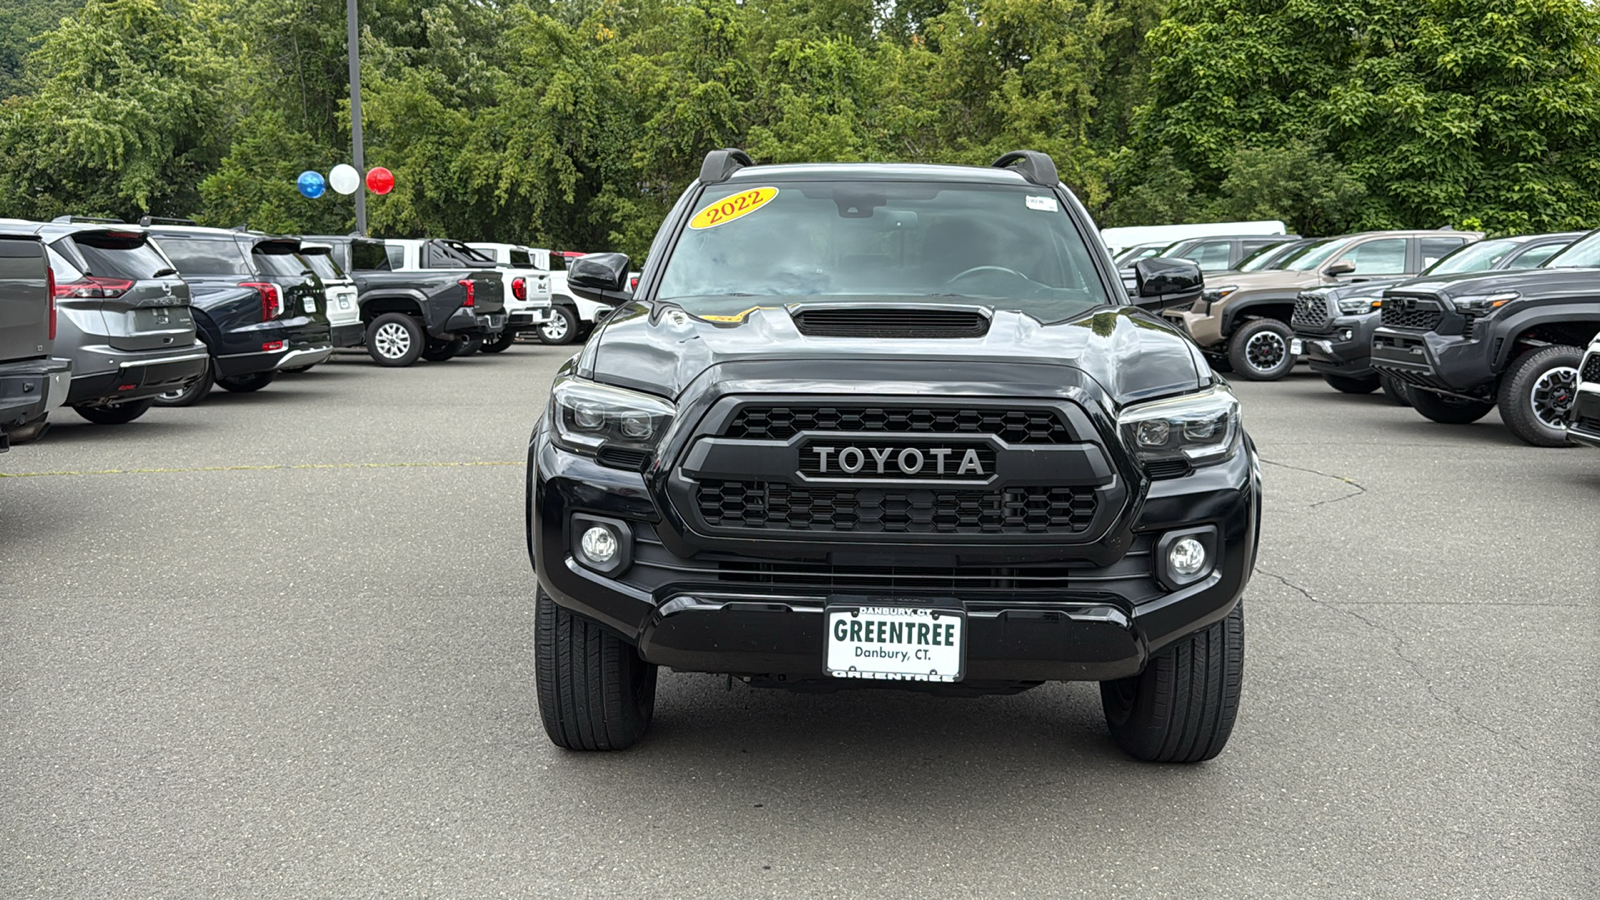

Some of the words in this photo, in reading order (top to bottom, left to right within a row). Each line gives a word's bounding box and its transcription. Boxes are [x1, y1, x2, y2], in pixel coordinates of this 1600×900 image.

[706, 191, 764, 224] 2022
[812, 446, 985, 475] TOYOTA
[859, 606, 915, 618] DANBURY,
[833, 619, 955, 647] GREENTREE
[854, 646, 911, 662] Danbury,
[915, 649, 931, 661] CT.
[831, 670, 955, 683] GREENTREE
